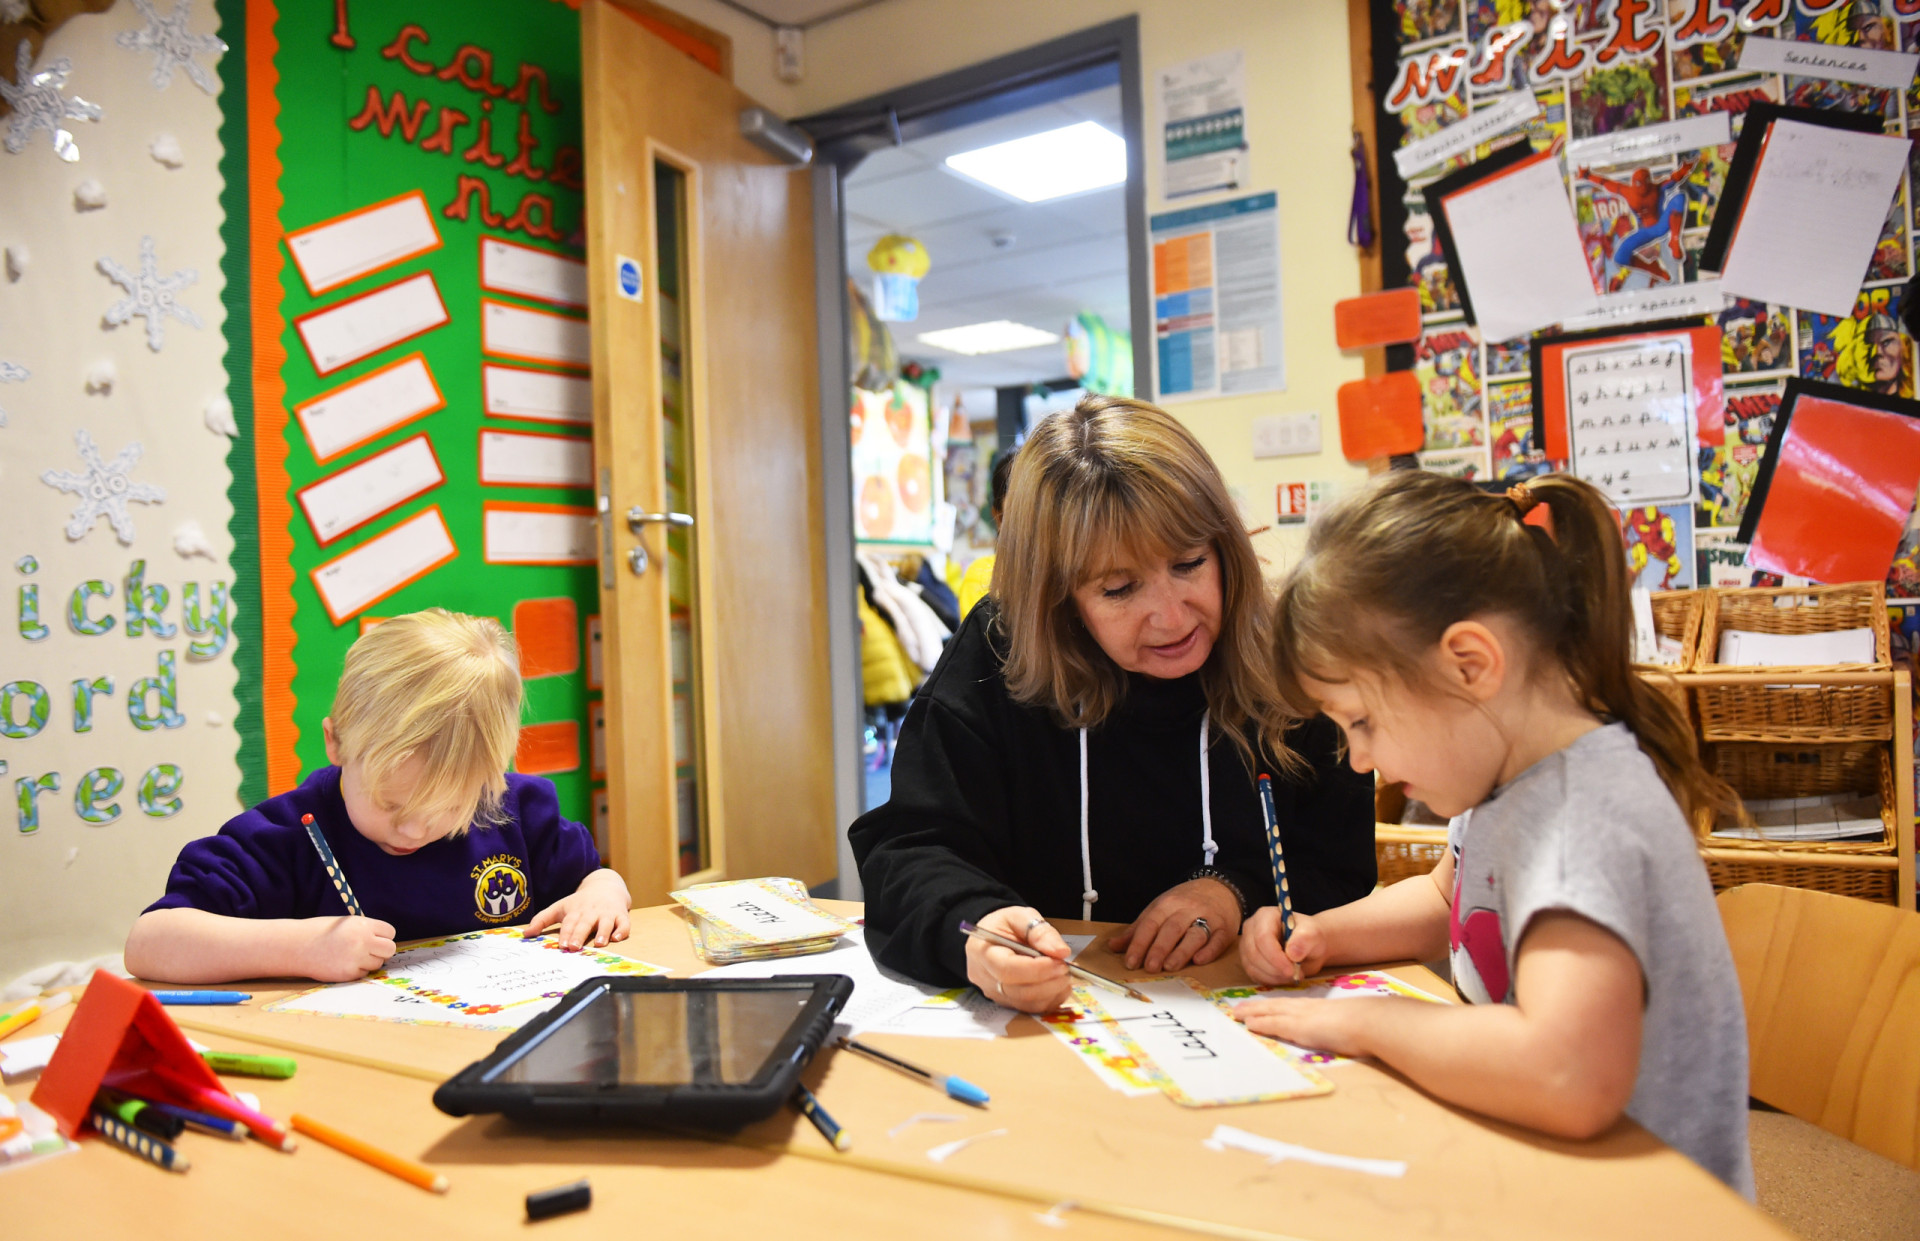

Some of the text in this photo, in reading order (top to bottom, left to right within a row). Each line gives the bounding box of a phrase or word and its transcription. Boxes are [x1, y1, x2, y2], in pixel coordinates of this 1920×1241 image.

[331, 0, 355, 48] I
[381, 24, 560, 113] can
[1784, 51, 1869, 72] Sentences
[349, 84, 586, 189] write
[443, 175, 587, 246] na
[137, 278, 174, 310] be
[90, 470, 127, 499] do
[15, 555, 230, 658] icky
[0, 650, 186, 739] ord
[0, 759, 184, 834] ree
[482, 853, 522, 869] MARY'S
